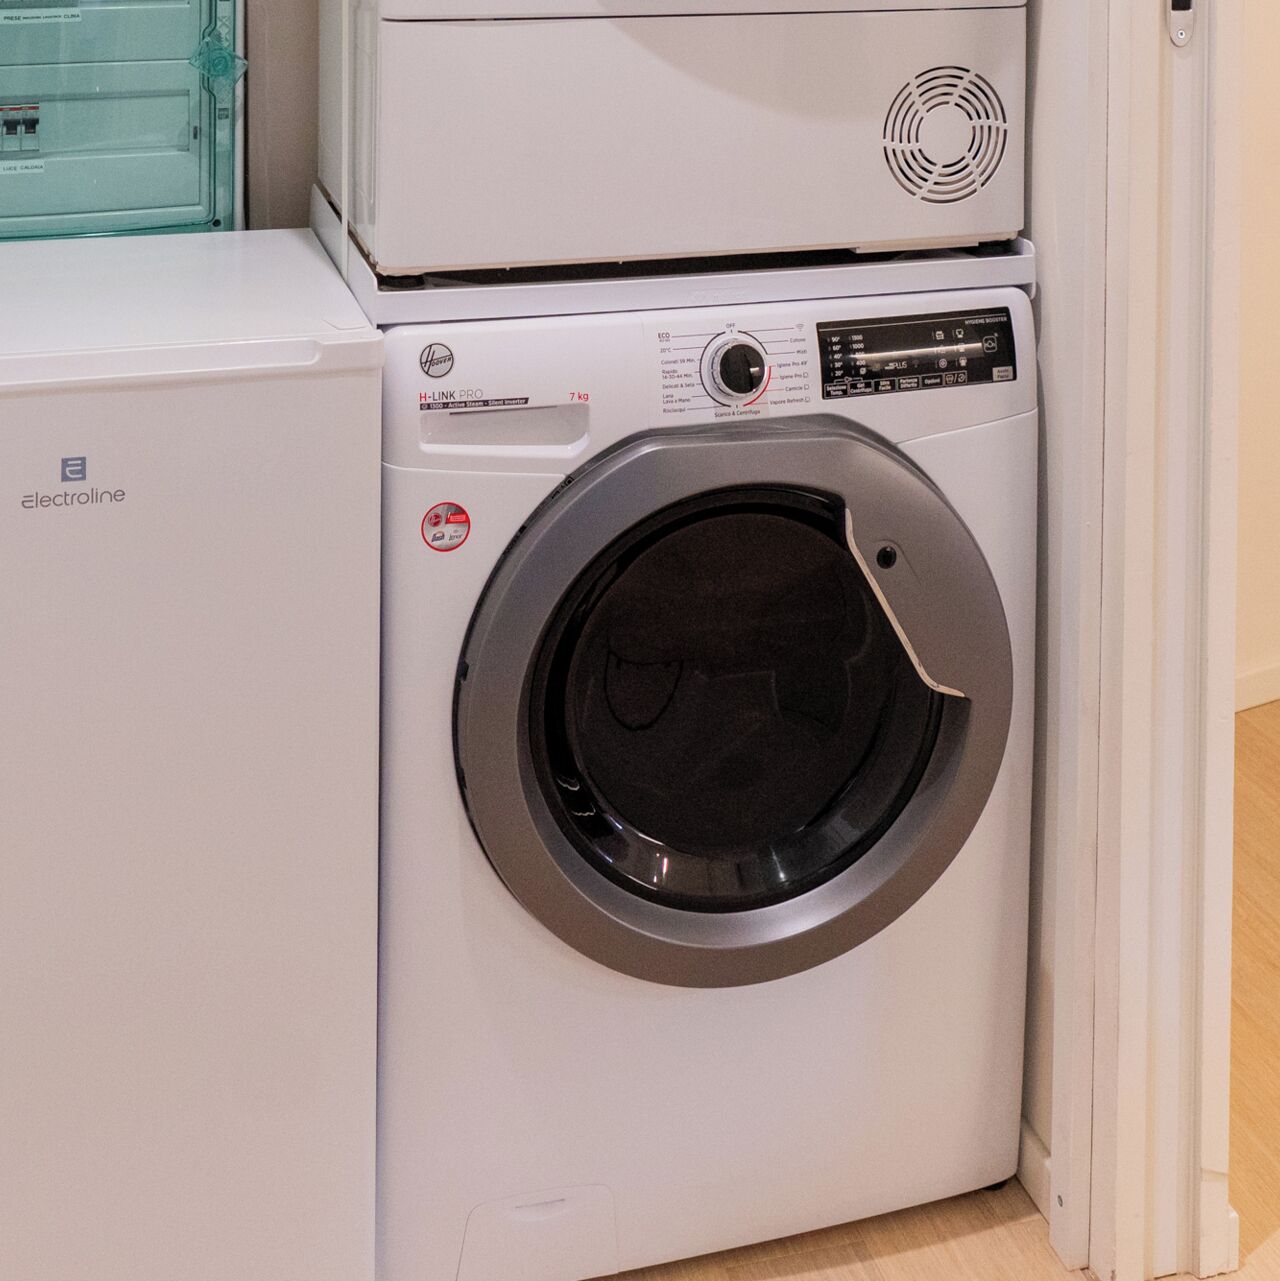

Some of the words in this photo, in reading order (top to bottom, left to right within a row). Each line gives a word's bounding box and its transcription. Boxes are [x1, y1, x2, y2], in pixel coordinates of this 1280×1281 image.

[420, 391, 455, 402] H-LINK
[459, 389, 483, 400] PRO
[570, 392, 574, 401] 7
[577, 391, 589, 403] kg
[448, 401, 465, 409] Active
[467, 400, 483, 408] Steam
[488, 399, 504, 407] Silent
[505, 398, 526, 406] Inverter
[21, 487, 126, 509] Electroline
